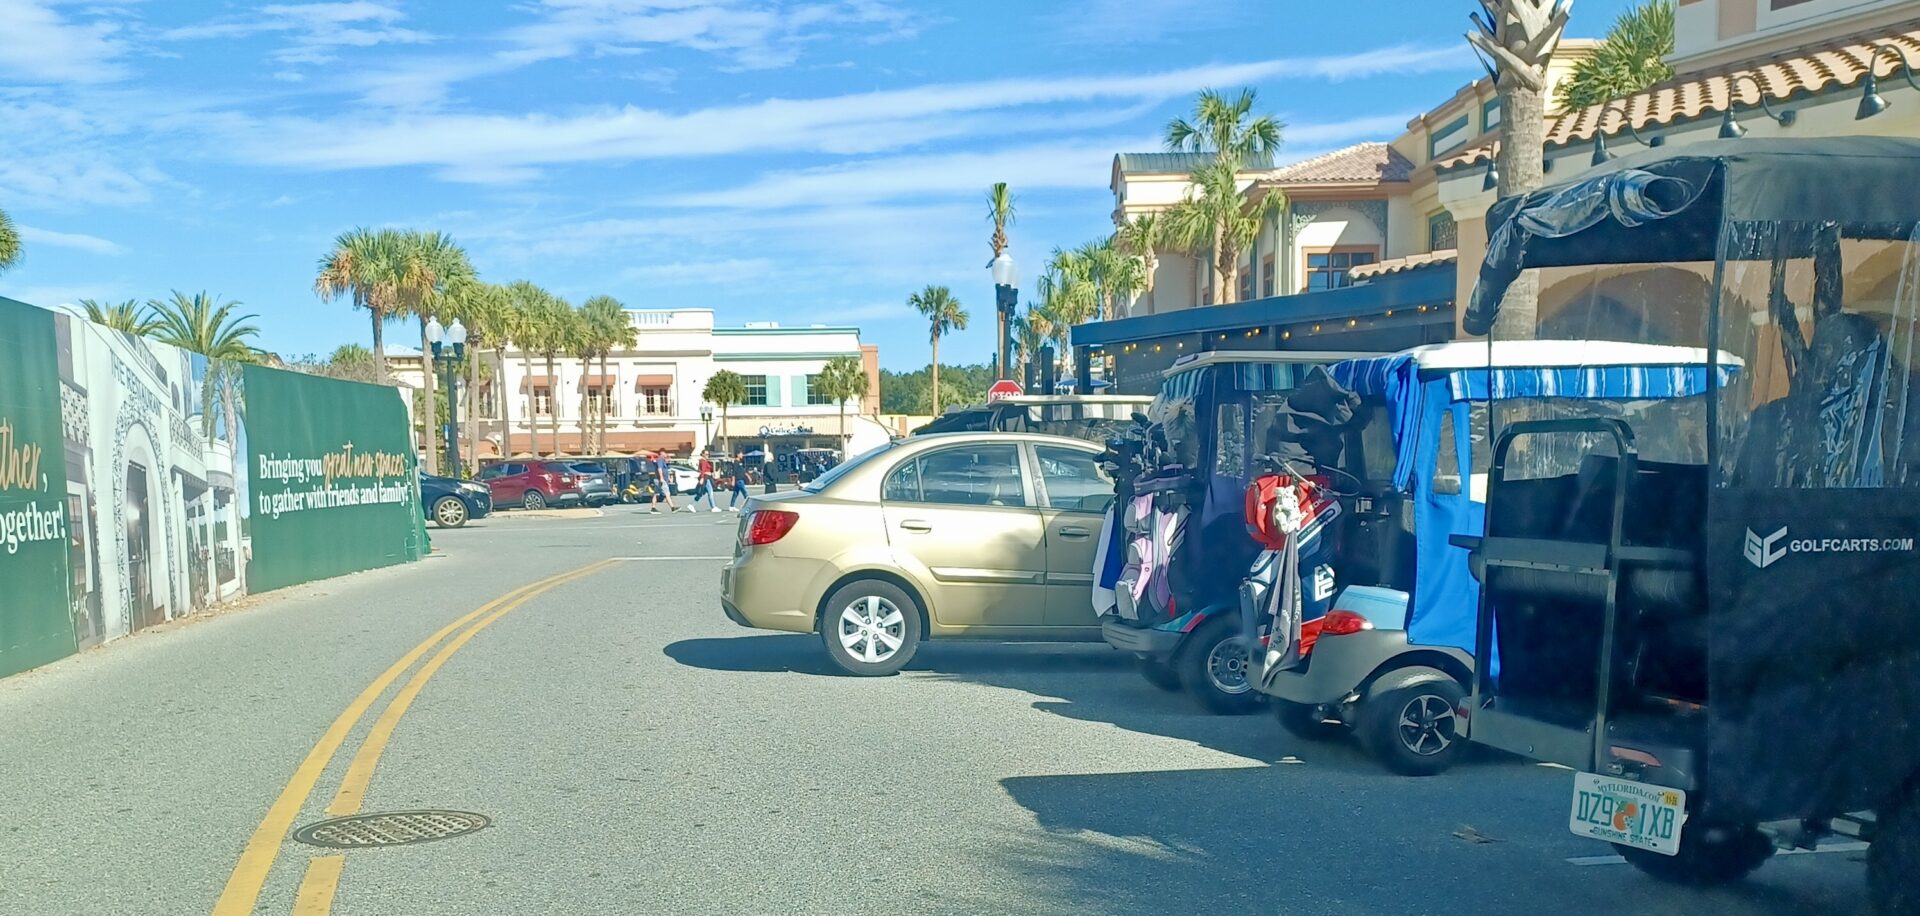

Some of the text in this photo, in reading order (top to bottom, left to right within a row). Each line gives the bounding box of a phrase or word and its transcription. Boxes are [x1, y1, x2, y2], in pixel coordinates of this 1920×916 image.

[991, 391, 1020, 400] STOP
[259, 440, 405, 492] Bringing you great new spaces
[259, 480, 409, 519] to gather with friends and family!
[1790, 538, 1914, 552] GOLFCARTS.COM
[1577, 790, 1675, 839] DZ9 1XB
[1592, 826, 1653, 847] SUNSHINE STATE
